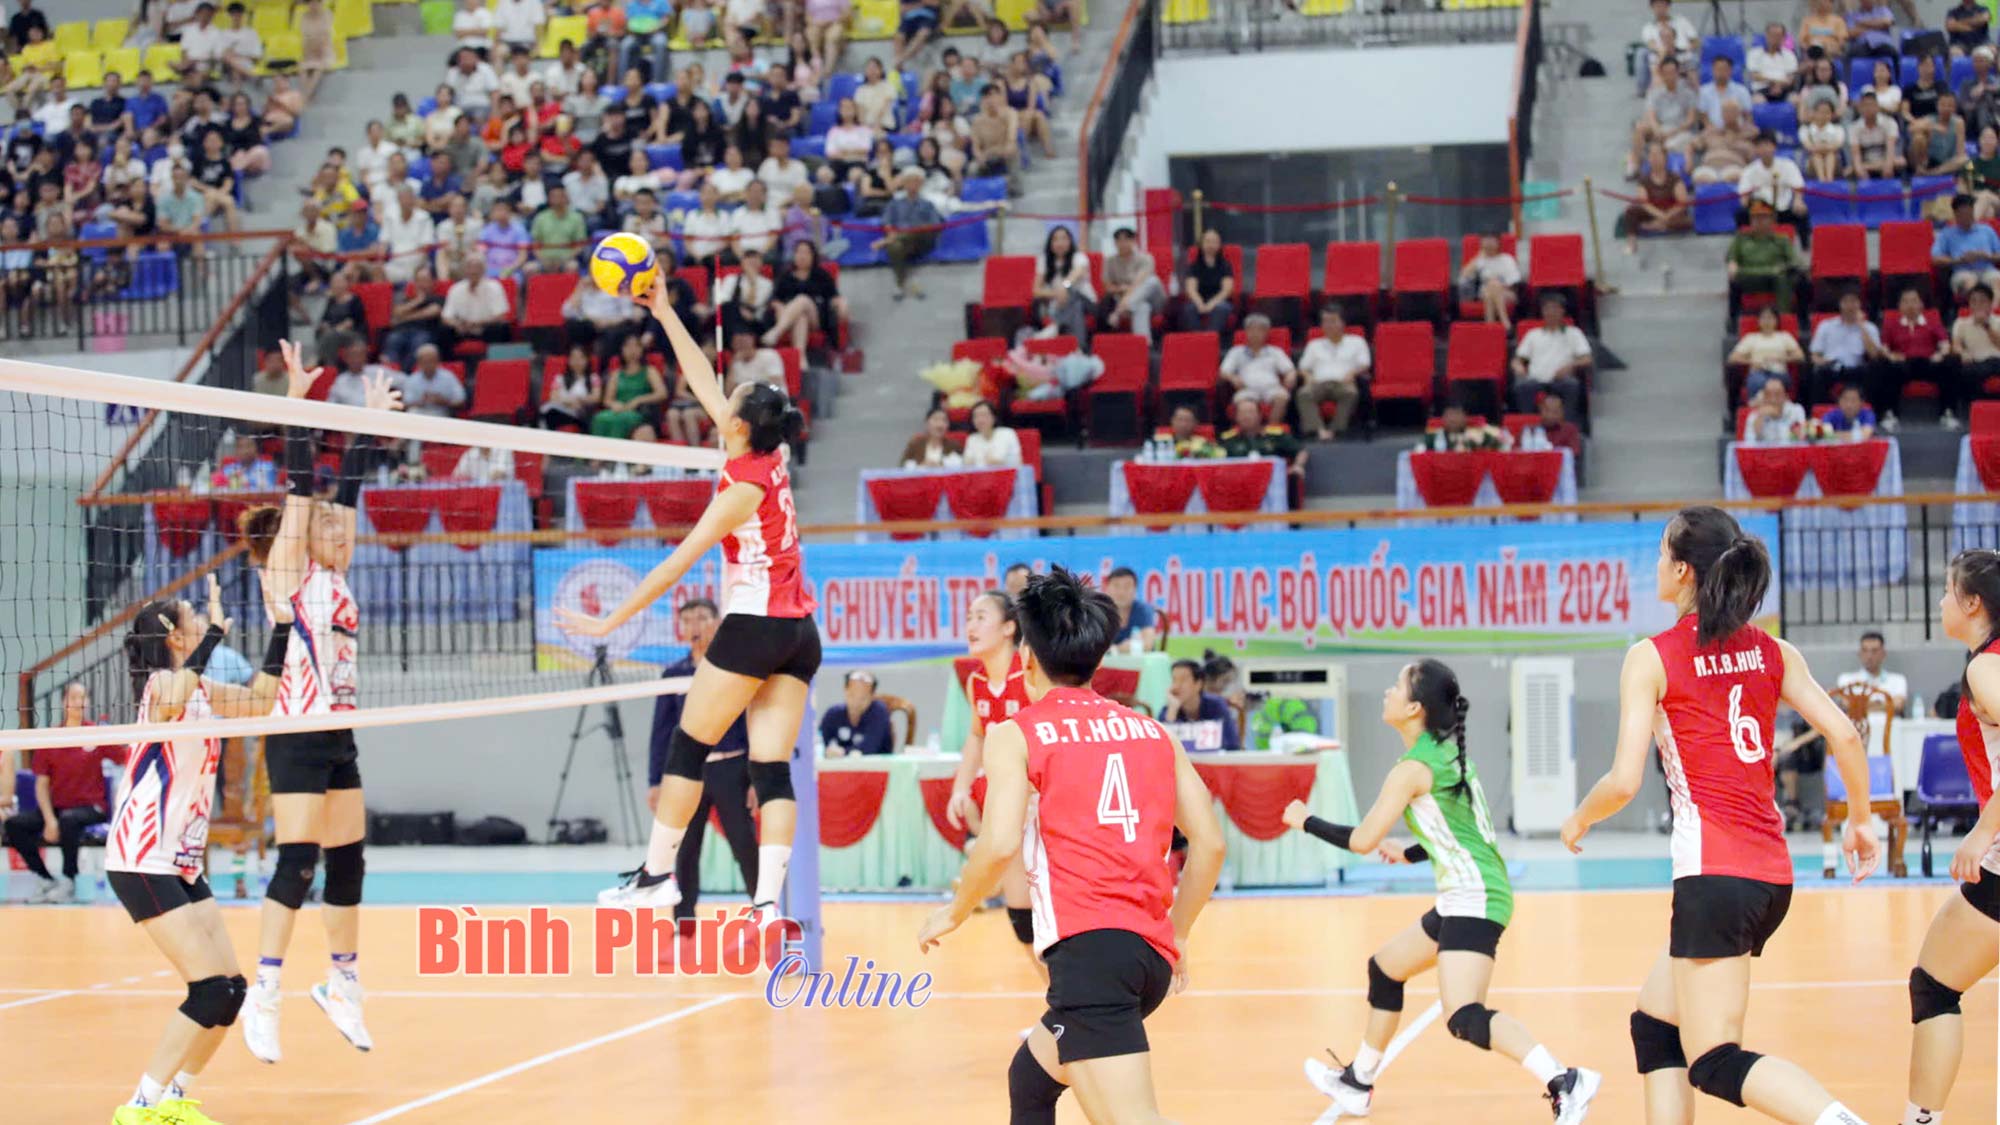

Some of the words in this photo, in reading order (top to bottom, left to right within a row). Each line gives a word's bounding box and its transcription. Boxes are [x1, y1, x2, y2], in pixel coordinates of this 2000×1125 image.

[1214, 570, 1269, 648] LẠC
[1279, 553, 1319, 648] BỘ
[1329, 541, 1409, 640] QUỐC
[1418, 564, 1468, 628] GIA
[1477, 548, 1548, 626] NĂM
[1558, 560, 1631, 623] 2024
[1693, 645, 1766, 678] N.T.B.HUỆ
[1728, 684, 1766, 764] 6
[1096, 752, 1140, 843] 4
